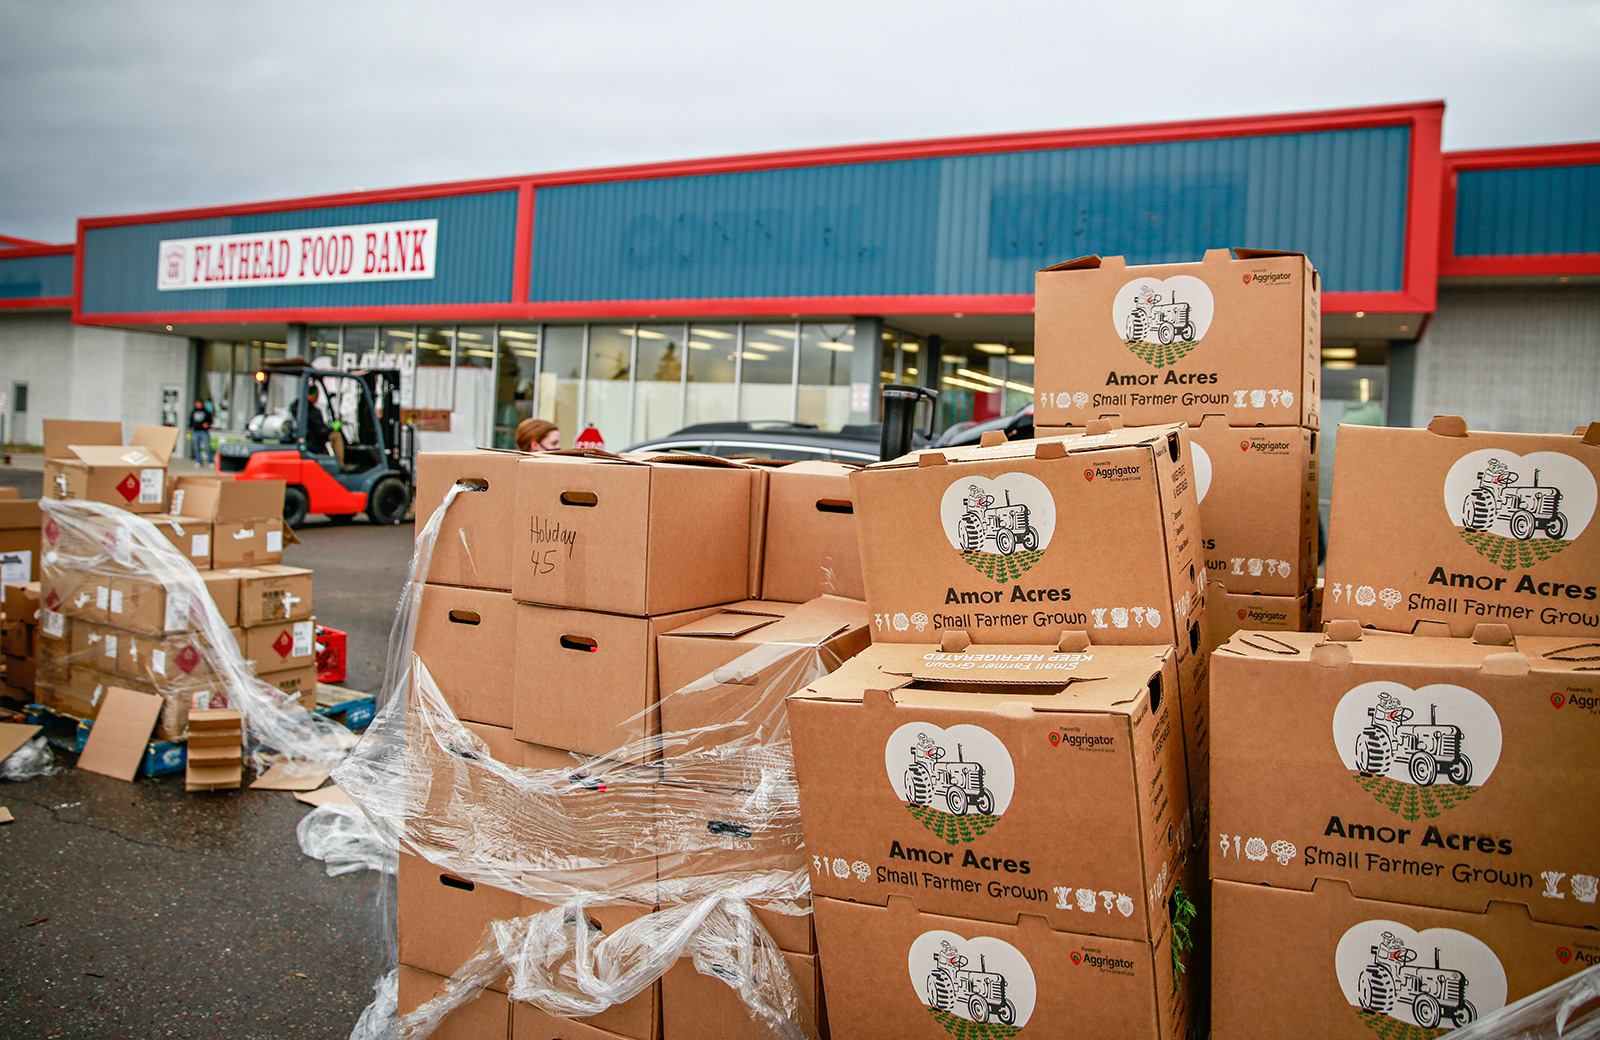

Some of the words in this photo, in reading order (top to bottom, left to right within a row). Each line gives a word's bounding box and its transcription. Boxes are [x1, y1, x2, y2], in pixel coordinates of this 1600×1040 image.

[193, 239, 290, 282] FLATHEAD
[299, 235, 354, 277] FOOD
[363, 229, 428, 274] BANK
[1252, 272, 1291, 283] Aggrigator
[1105, 371, 1158, 386] Amor
[1163, 370, 1218, 385] Acres
[1092, 393, 1127, 408] Small
[1130, 393, 1178, 406] Farmer
[1181, 392, 1229, 406] Grown
[1250, 441, 1290, 452] Aggrigator
[1095, 466, 1140, 479] Aggrigator
[530, 516, 576, 559] Holiday
[531, 549, 556, 576] 45
[1427, 566, 1507, 591] Amor
[1514, 574, 1598, 600] Acres
[944, 587, 1003, 605] Amor
[1010, 585, 1072, 603] Acres
[1408, 593, 1457, 613] Small
[1464, 599, 1534, 619] Farmer
[933, 613, 971, 630] Small
[974, 613, 1028, 628] Farmer
[1033, 611, 1087, 627] Grown
[1248, 610, 1287, 621] Aggrigator
[922, 653, 1045, 662] REFRIGERATED
[924, 661, 976, 670] Grown
[1047, 654, 1094, 662] KEEP
[977, 662, 1032, 671] Farmer
[1035, 661, 1079, 671] Small
[1062, 733, 1114, 747] Aggrigator
[1323, 815, 1411, 845] Amor
[1420, 825, 1513, 856] Acres
[889, 840, 954, 865] Amor
[961, 849, 1031, 875] Acres
[1304, 845, 1359, 869] Small
[1365, 852, 1445, 877] Farmer
[1452, 863, 1533, 889] Grown
[876, 866, 919, 887] Small
[922, 872, 982, 893] Farmer
[987, 881, 1048, 902] Grown
[1083, 953, 1134, 969] Aggrigator
